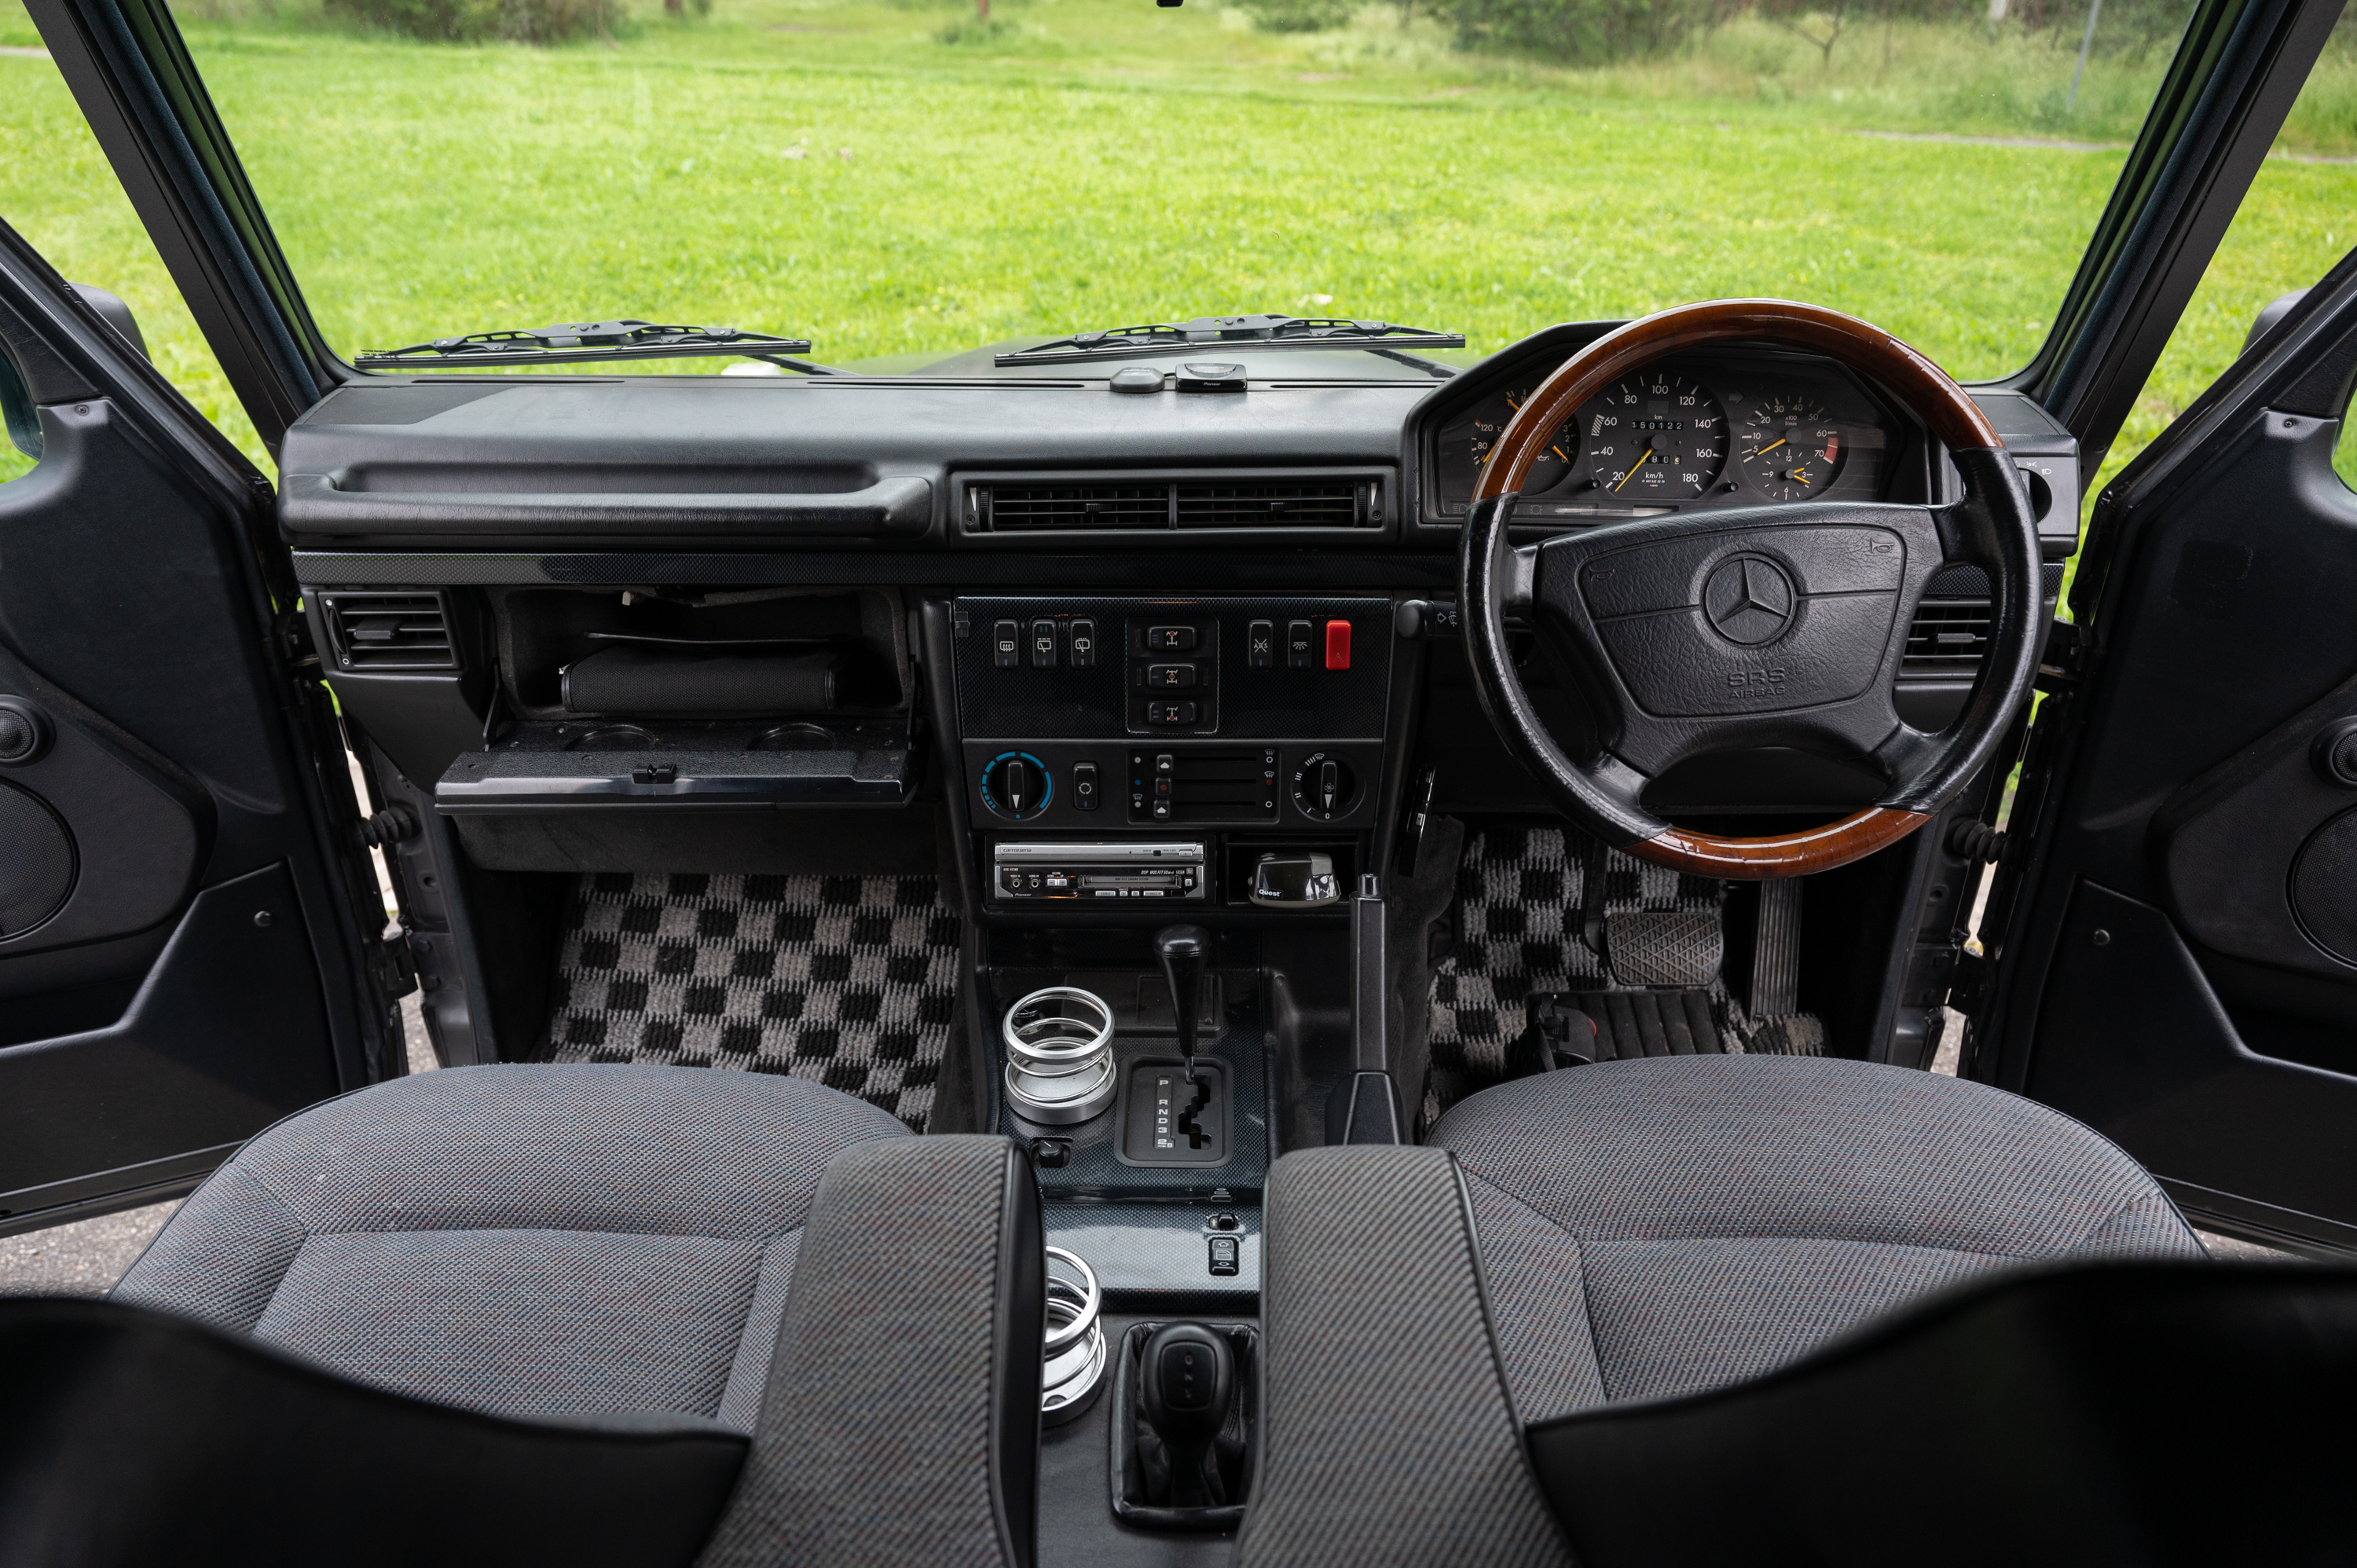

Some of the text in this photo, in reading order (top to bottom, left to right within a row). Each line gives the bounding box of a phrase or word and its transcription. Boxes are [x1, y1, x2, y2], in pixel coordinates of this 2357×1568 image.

[1651, 385, 1669, 394] 100
[1624, 394, 1637, 404] 80
[1679, 396, 1695, 405] 120
[1604, 416, 1618, 427] 60
[1695, 419, 1711, 429] 140
[1600, 446, 1614, 456] 40
[1695, 449, 1713, 458] 160
[1612, 471, 1625, 481] 20
[1682, 473, 1699, 482] 180
[1728, 668, 1785, 687] SRS
[1729, 686, 1786, 698] AIRBAG
[1259, 888, 1281, 897] Quest
